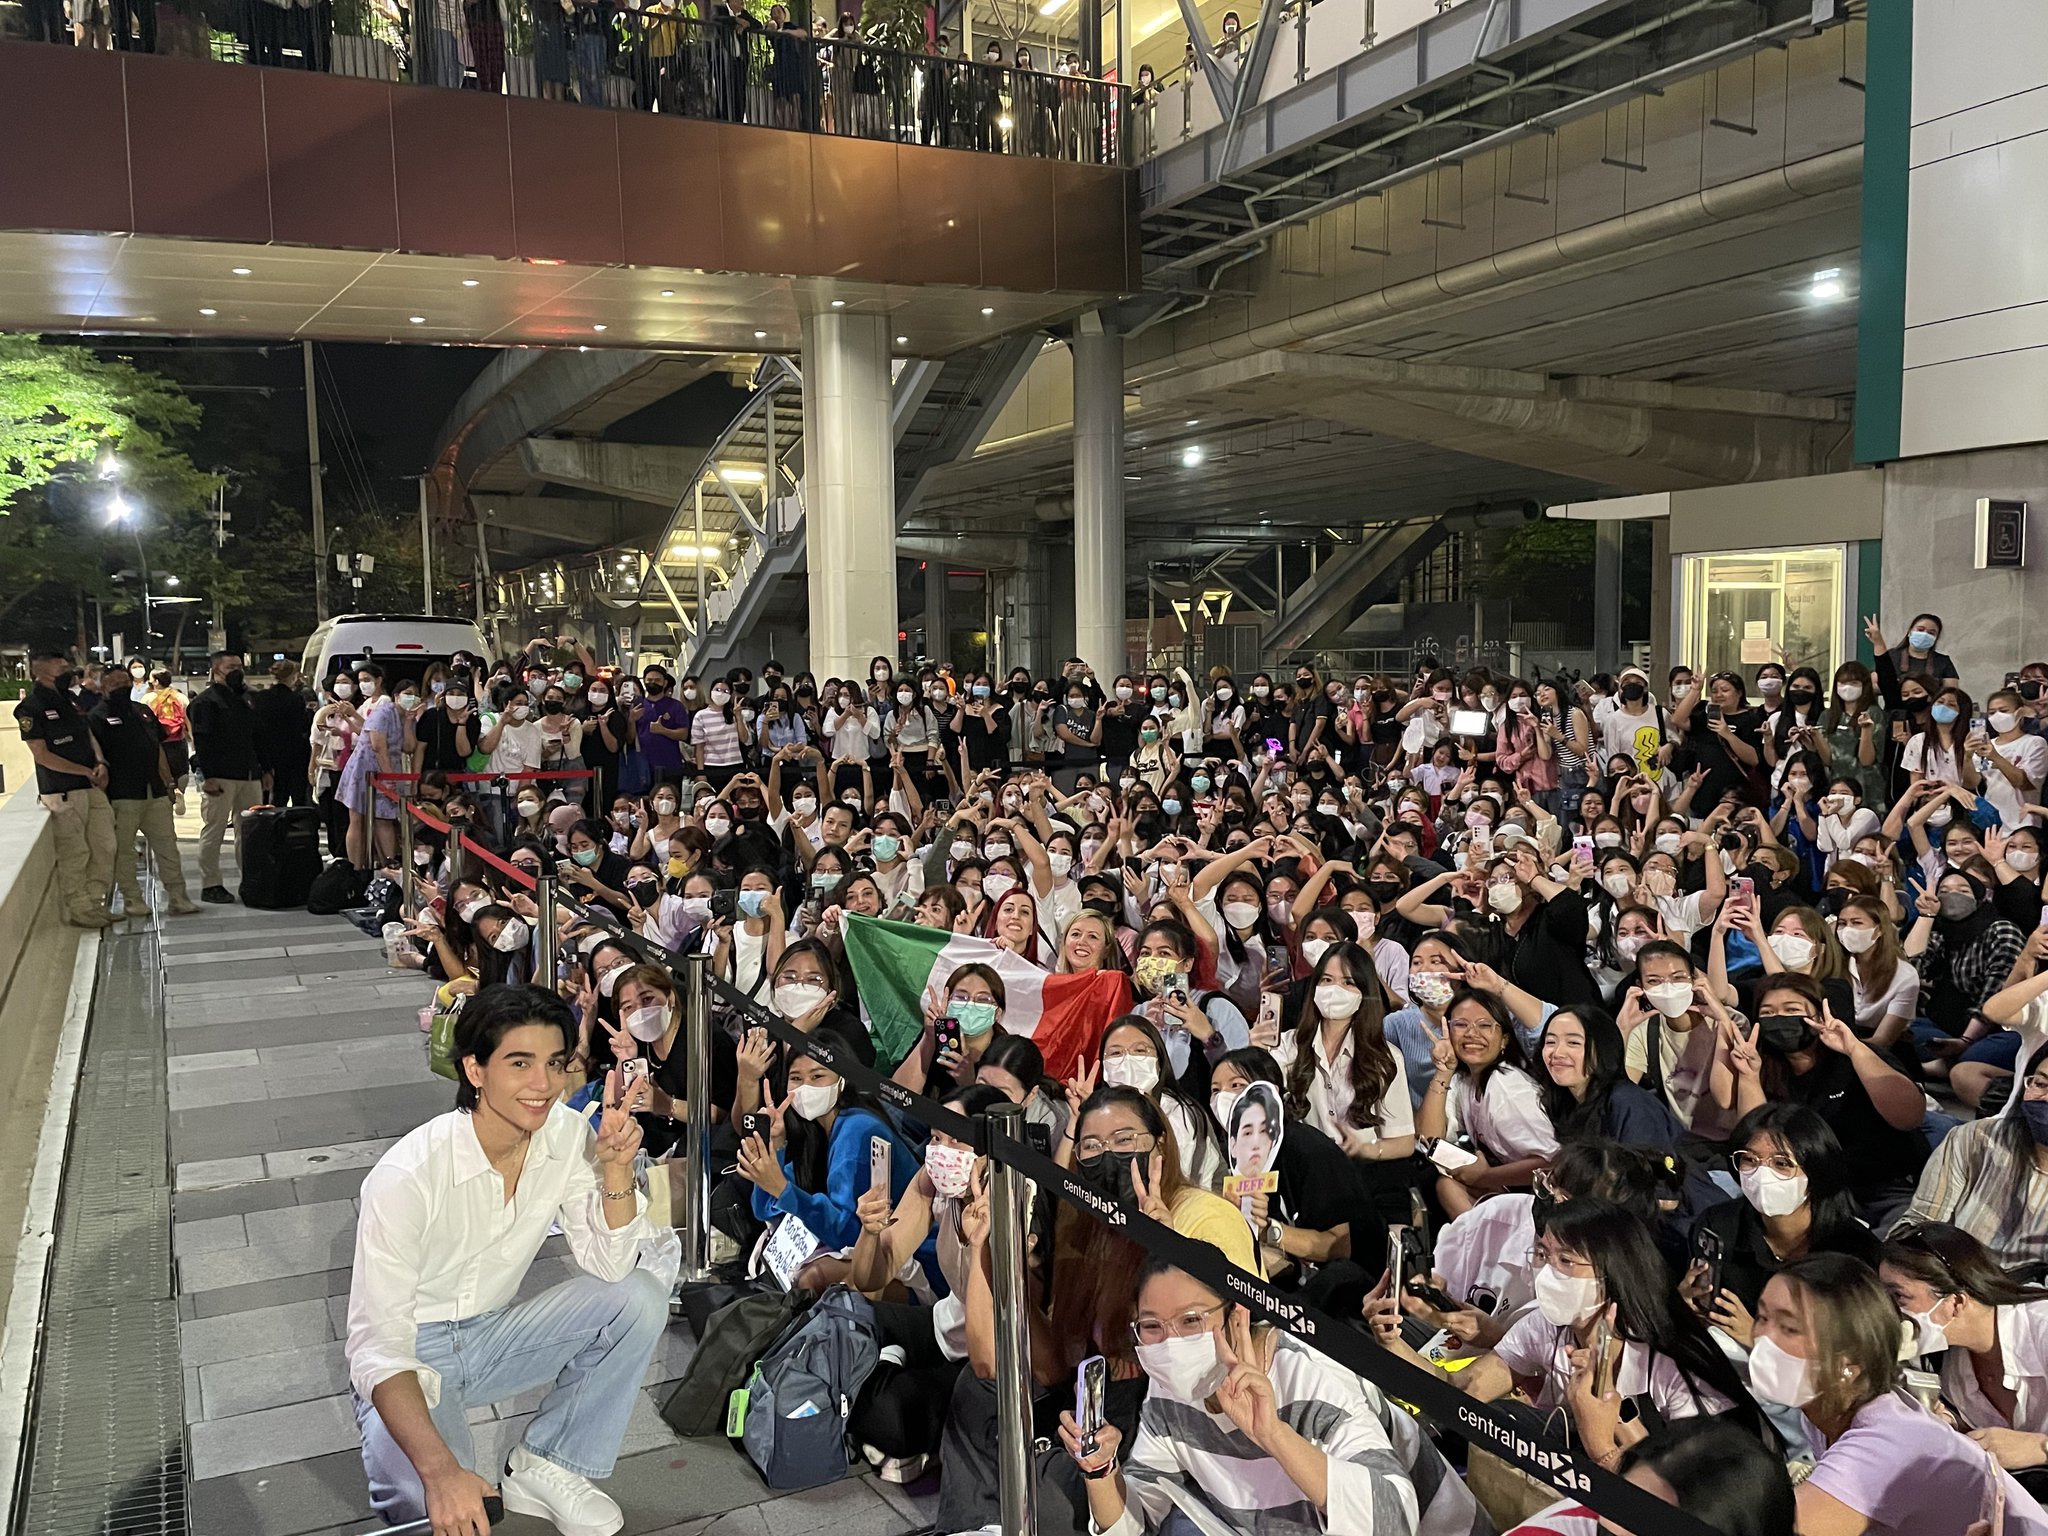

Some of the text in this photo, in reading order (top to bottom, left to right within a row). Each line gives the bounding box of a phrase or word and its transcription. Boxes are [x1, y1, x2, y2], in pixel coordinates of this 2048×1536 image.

[1236, 1178, 1265, 1192] JEFF
[1226, 1273, 1316, 1335] centralplaza
[1458, 1406, 1592, 1493] centralplaza
